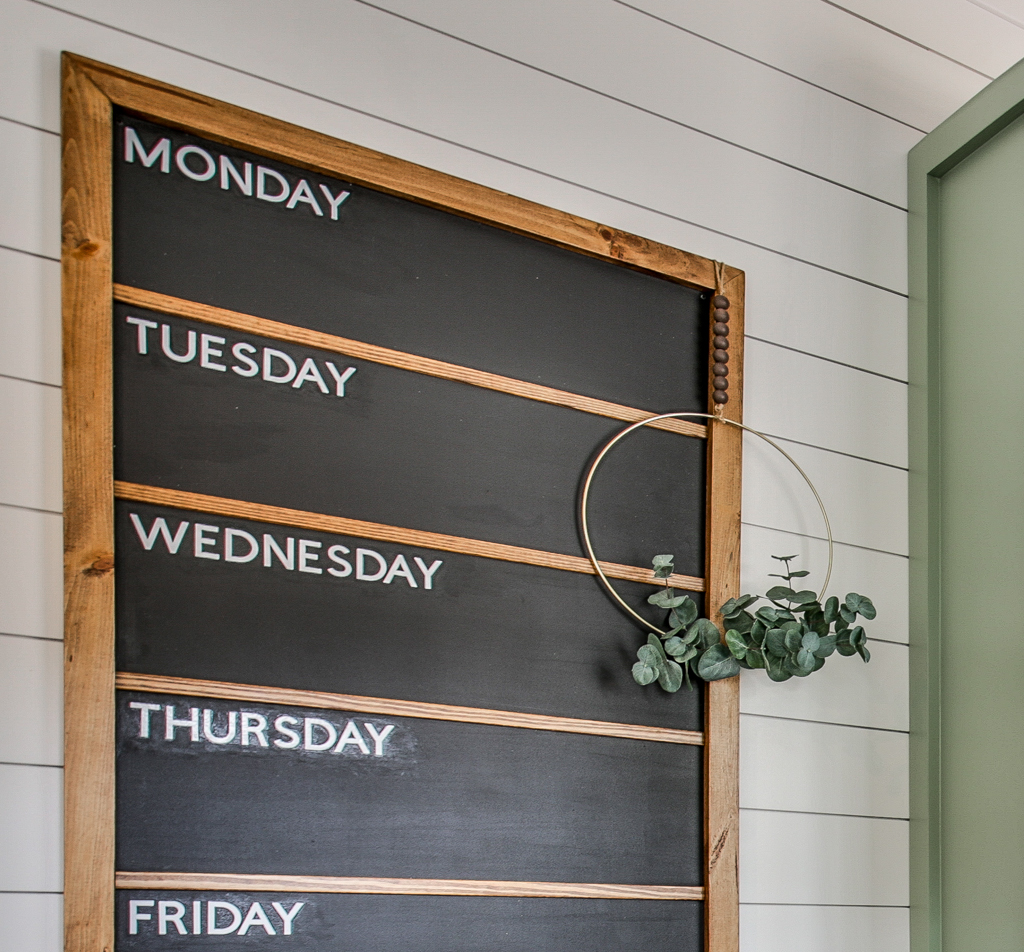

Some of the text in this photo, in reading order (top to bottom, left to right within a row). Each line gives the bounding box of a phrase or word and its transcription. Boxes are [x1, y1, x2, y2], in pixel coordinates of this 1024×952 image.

[123, 127, 350, 220] MONDAY
[126, 316, 356, 397] TUESDAY
[130, 513, 443, 589] WEDNESDAY
[129, 702, 394, 756] THURSDAY
[128, 900, 304, 936] FRIDAY
